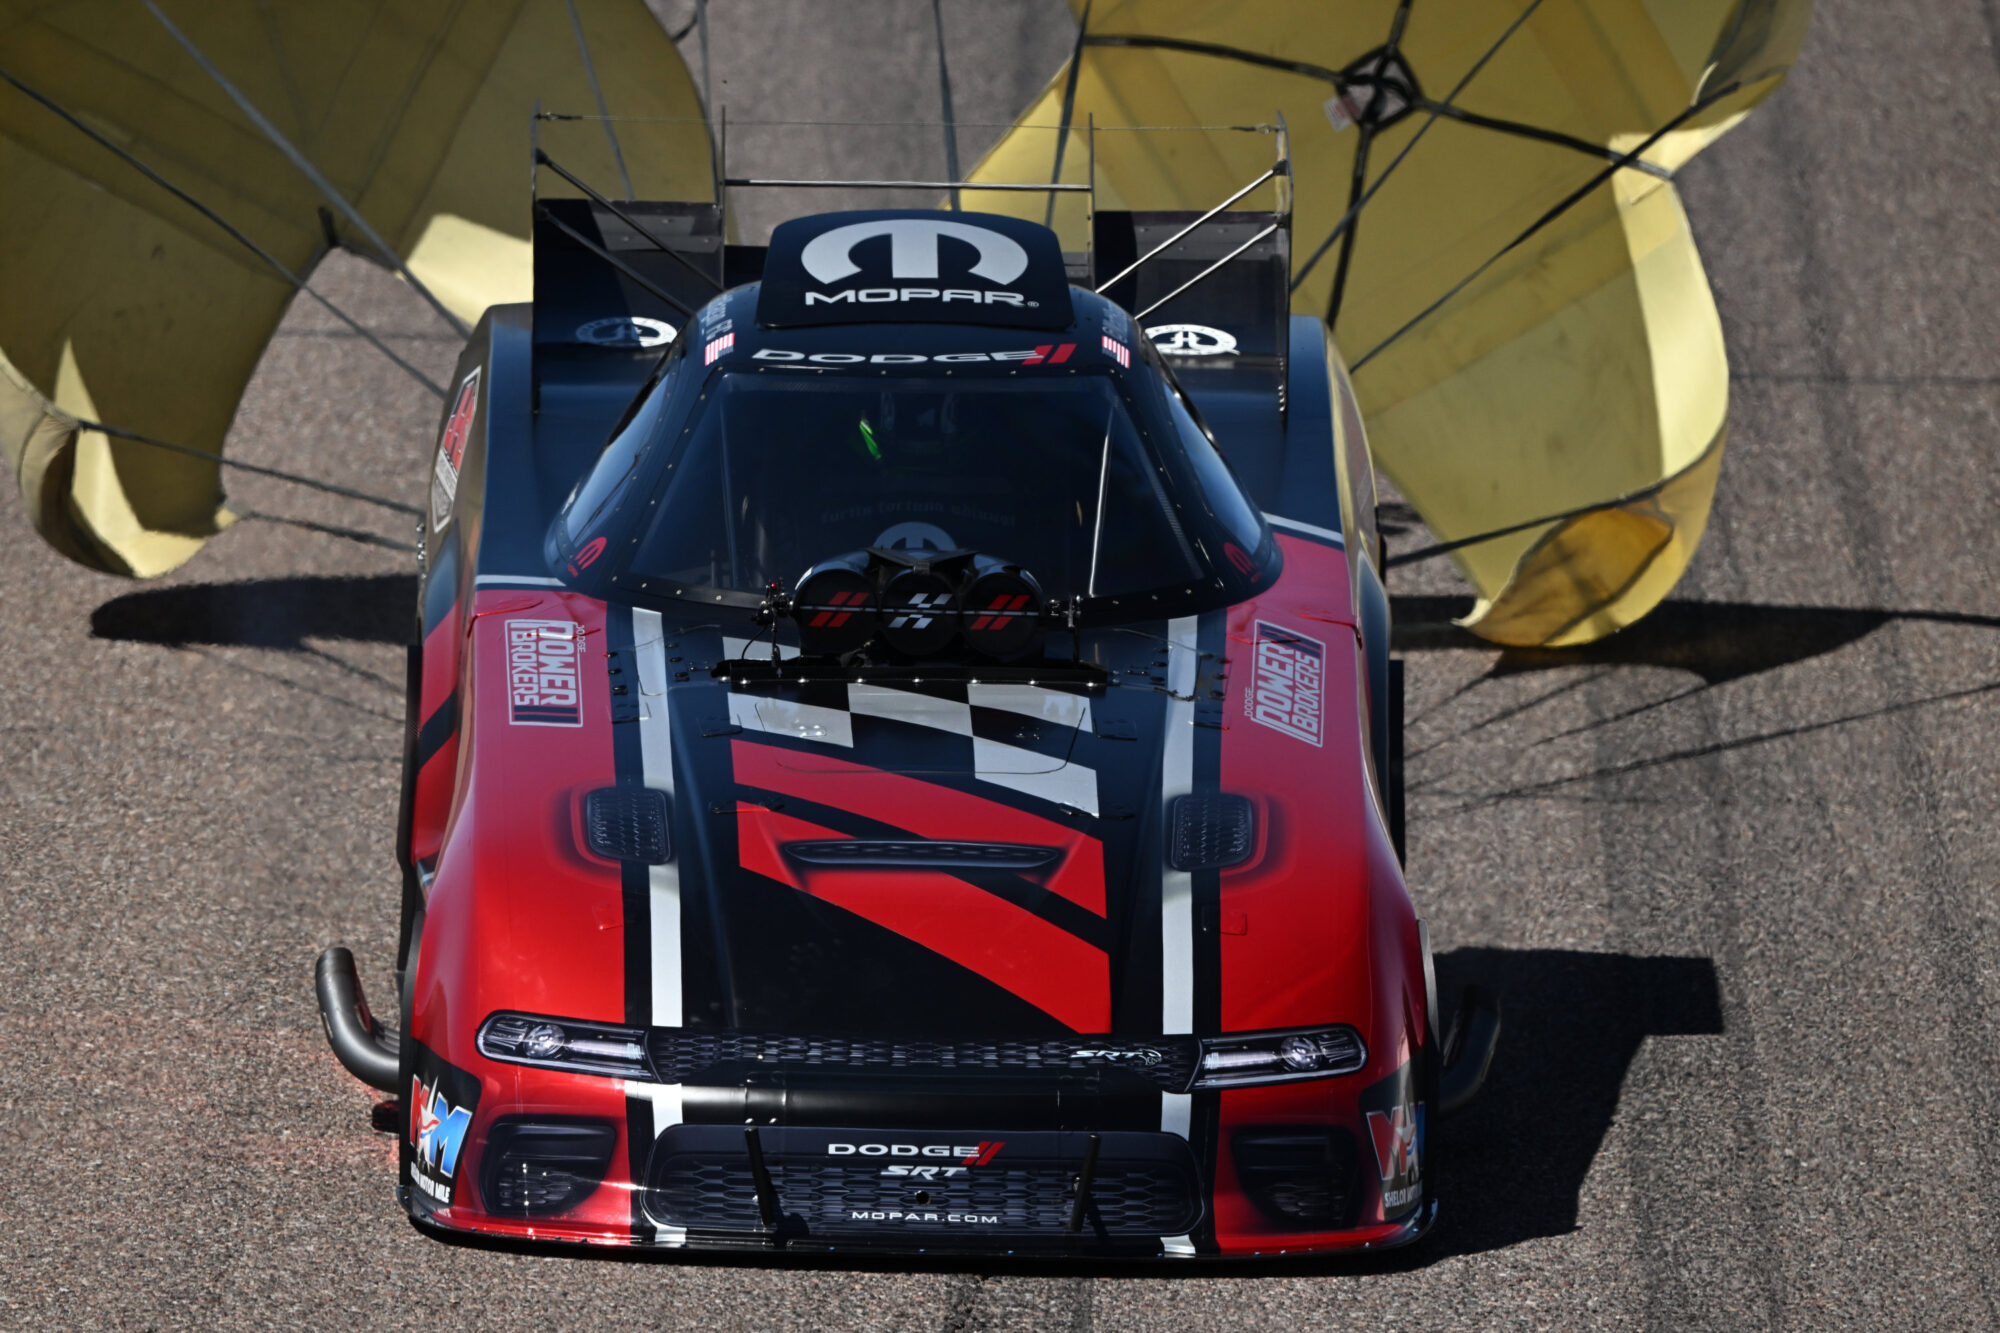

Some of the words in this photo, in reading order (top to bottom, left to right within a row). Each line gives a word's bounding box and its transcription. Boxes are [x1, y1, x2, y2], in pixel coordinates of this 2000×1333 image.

[752, 349, 1044, 364] DODGE
[511, 629, 540, 706] BROKERS
[538, 621, 577, 706] POWER
[1255, 639, 1295, 724] POWER
[1291, 650, 1320, 734] BROKERS
[1068, 1050, 1143, 1061] SRT
[828, 1143, 980, 1158] DODGE
[880, 1165, 968, 1181] SRT
[851, 1211, 998, 1224] MOPAR.COM
